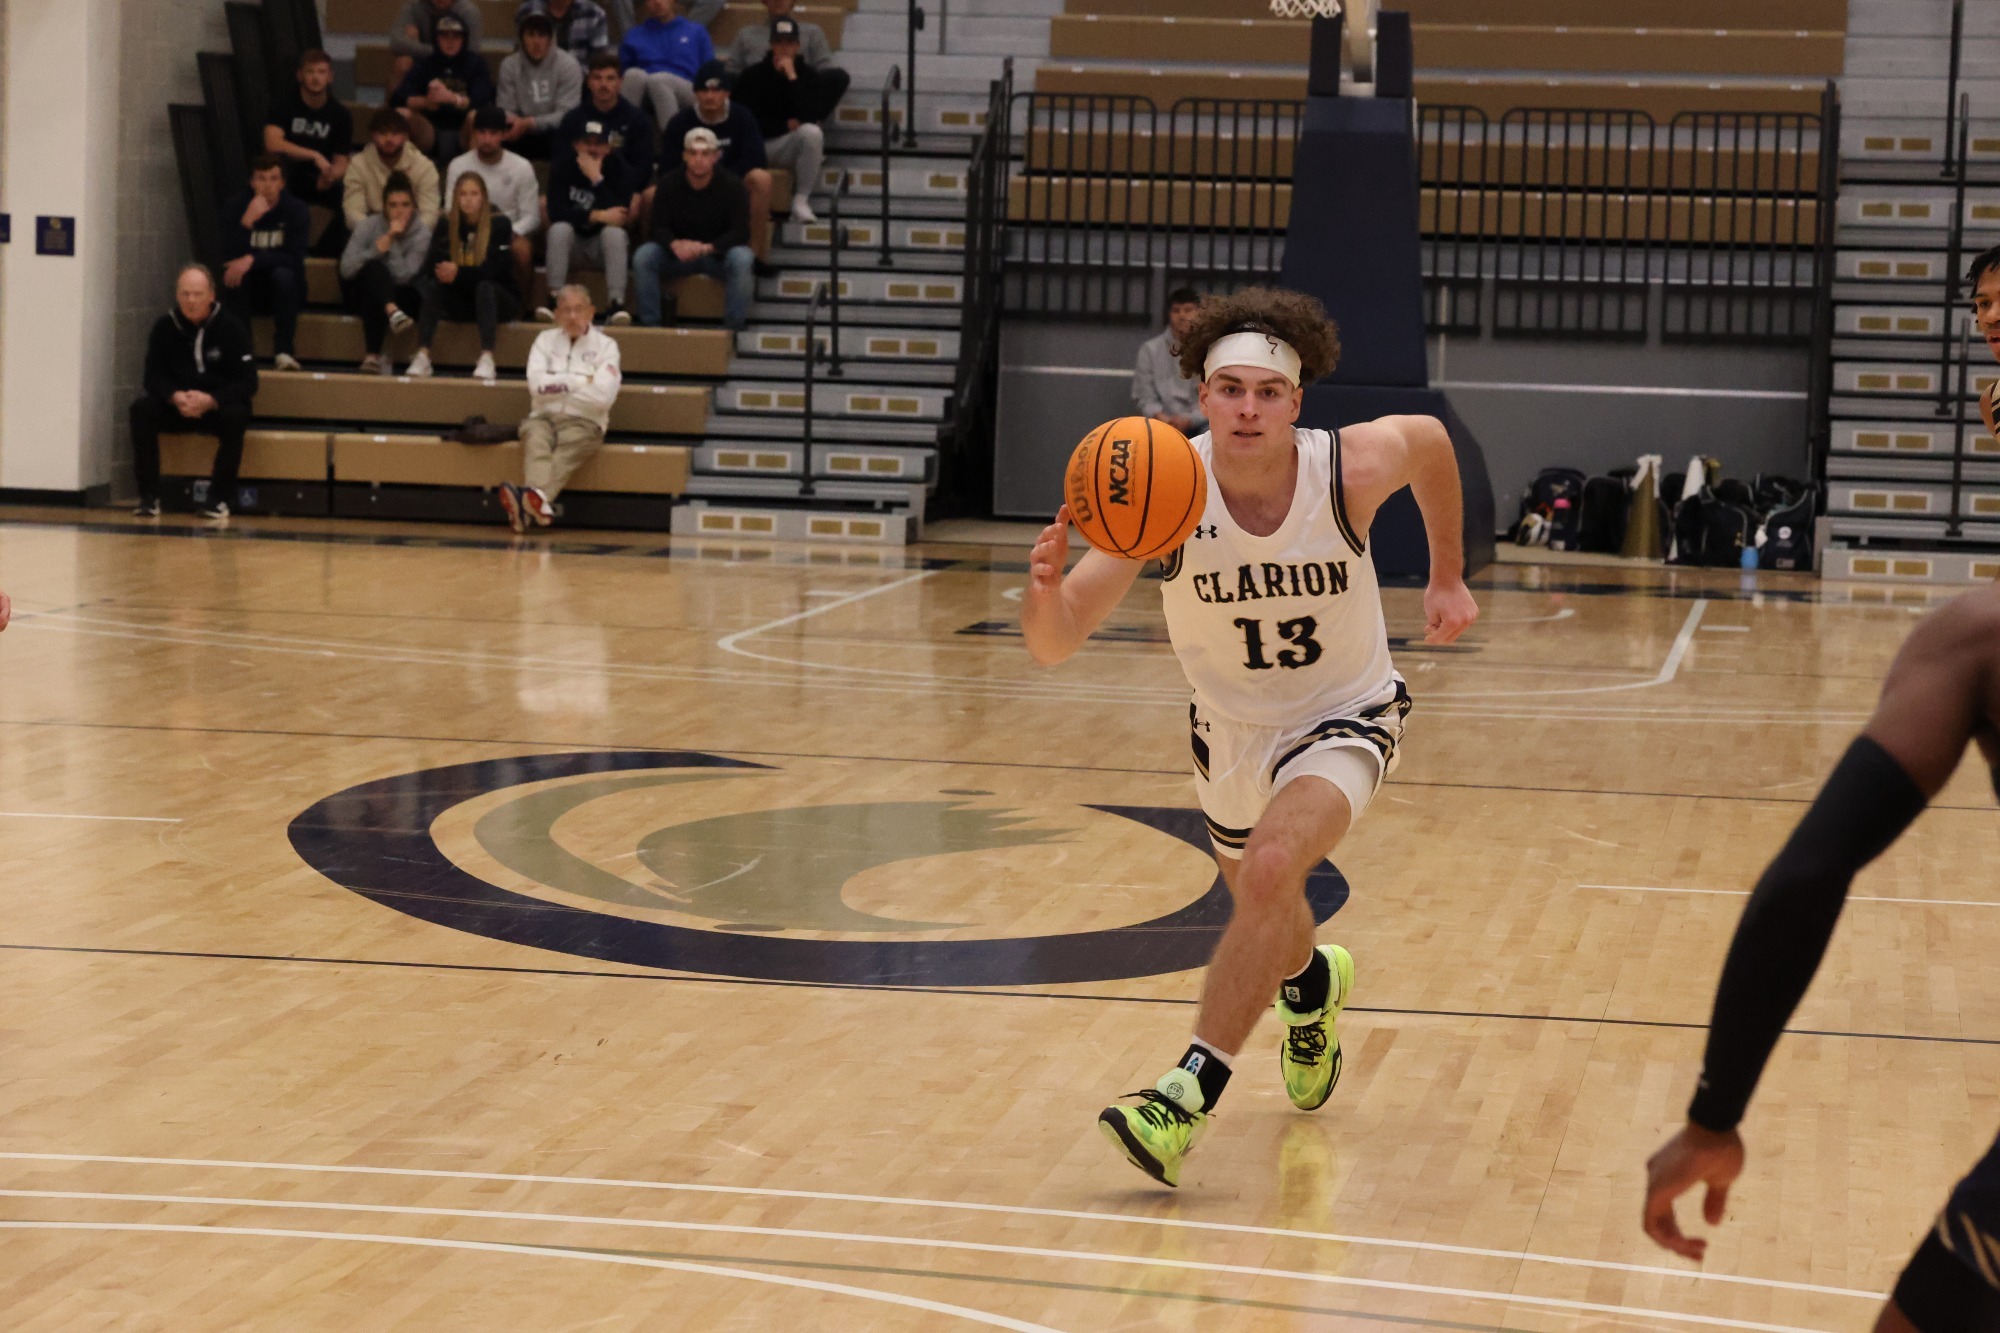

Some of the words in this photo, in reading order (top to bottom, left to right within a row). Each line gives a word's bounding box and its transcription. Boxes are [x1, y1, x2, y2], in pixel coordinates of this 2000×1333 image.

[1109, 439, 1132, 506] NCAA
[1193, 561, 1348, 603] CLARION
[1233, 615, 1326, 670] 13
